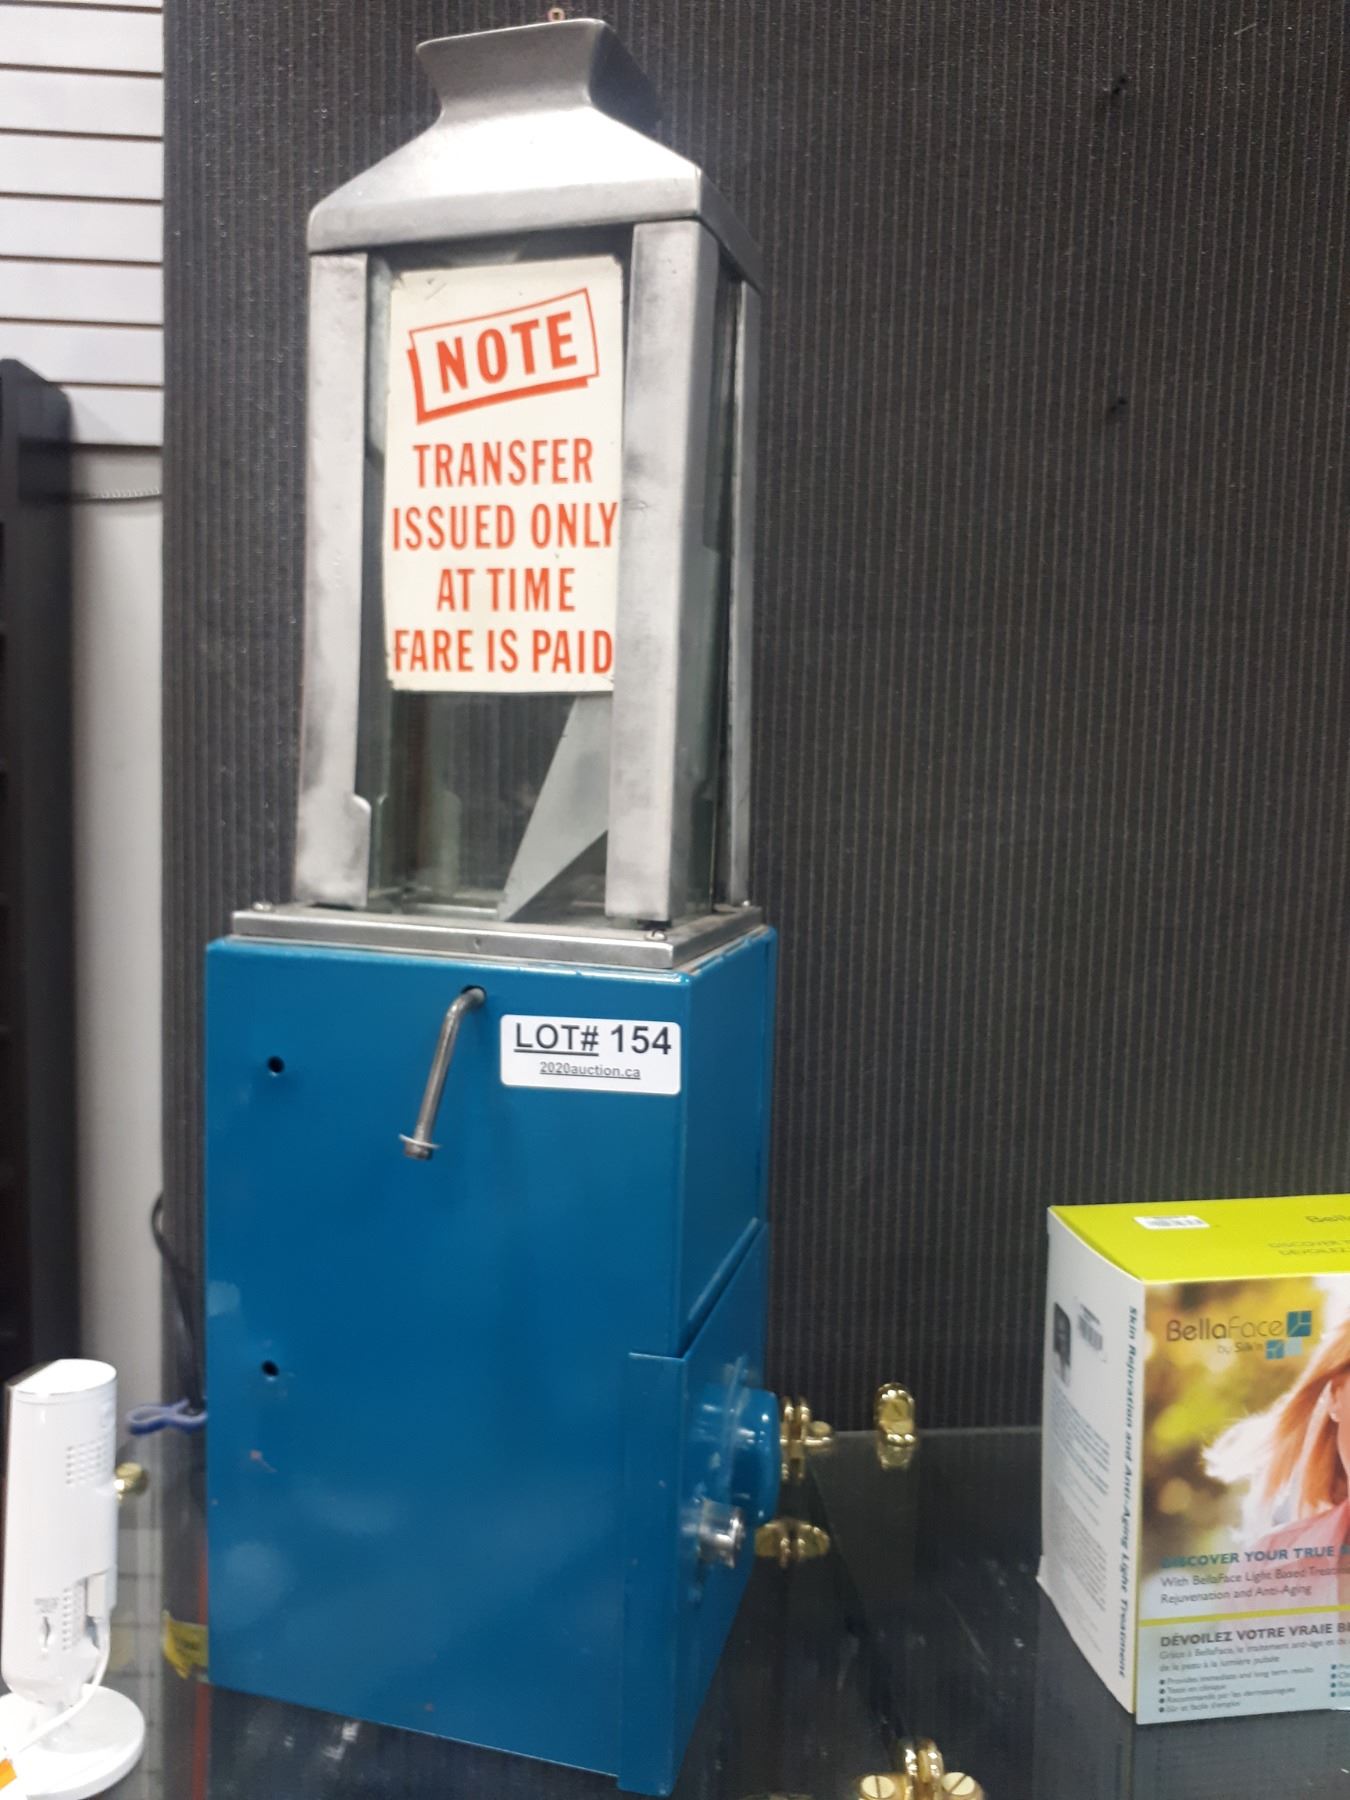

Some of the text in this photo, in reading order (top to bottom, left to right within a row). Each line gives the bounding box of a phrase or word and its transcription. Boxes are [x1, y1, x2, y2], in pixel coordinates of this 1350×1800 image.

[437, 311, 577, 394] NOTE
[413, 438, 593, 488] TRANSFER
[393, 502, 617, 551] ISSUED ONLY
[437, 567, 575, 612] AT TIME
[394, 629, 613, 674] FARE IS PAID
[515, 1022, 672, 1055] LOT# 154
[540, 1061, 641, 1079] 2020auction.ca
[1128, 1305, 1138, 1340] Skin
[1166, 1316, 1283, 1342] BellaFace
[1123, 1431, 1133, 1462] and
[1119, 1552, 1130, 1592] Light
[1161, 1552, 1240, 1568] DISCOVER
[1244, 1549, 1288, 1562] YOUR
[1293, 1546, 1334, 1558] TRUE
[1161, 1576, 1189, 1587] With
[1192, 1573, 1242, 1585] BellaFace
[1245, 1571, 1272, 1583] Light
[1275, 1568, 1307, 1579] Based
[1161, 1585, 1312, 1605] Rejuvenation and Anti-Aging
[1118, 1598, 1129, 1679] Treatment
[1161, 1631, 1232, 1647] DÉVOILEZ
[1237, 1628, 1285, 1640] VOTRE
[1289, 1623, 1333, 1636] VRAIE
